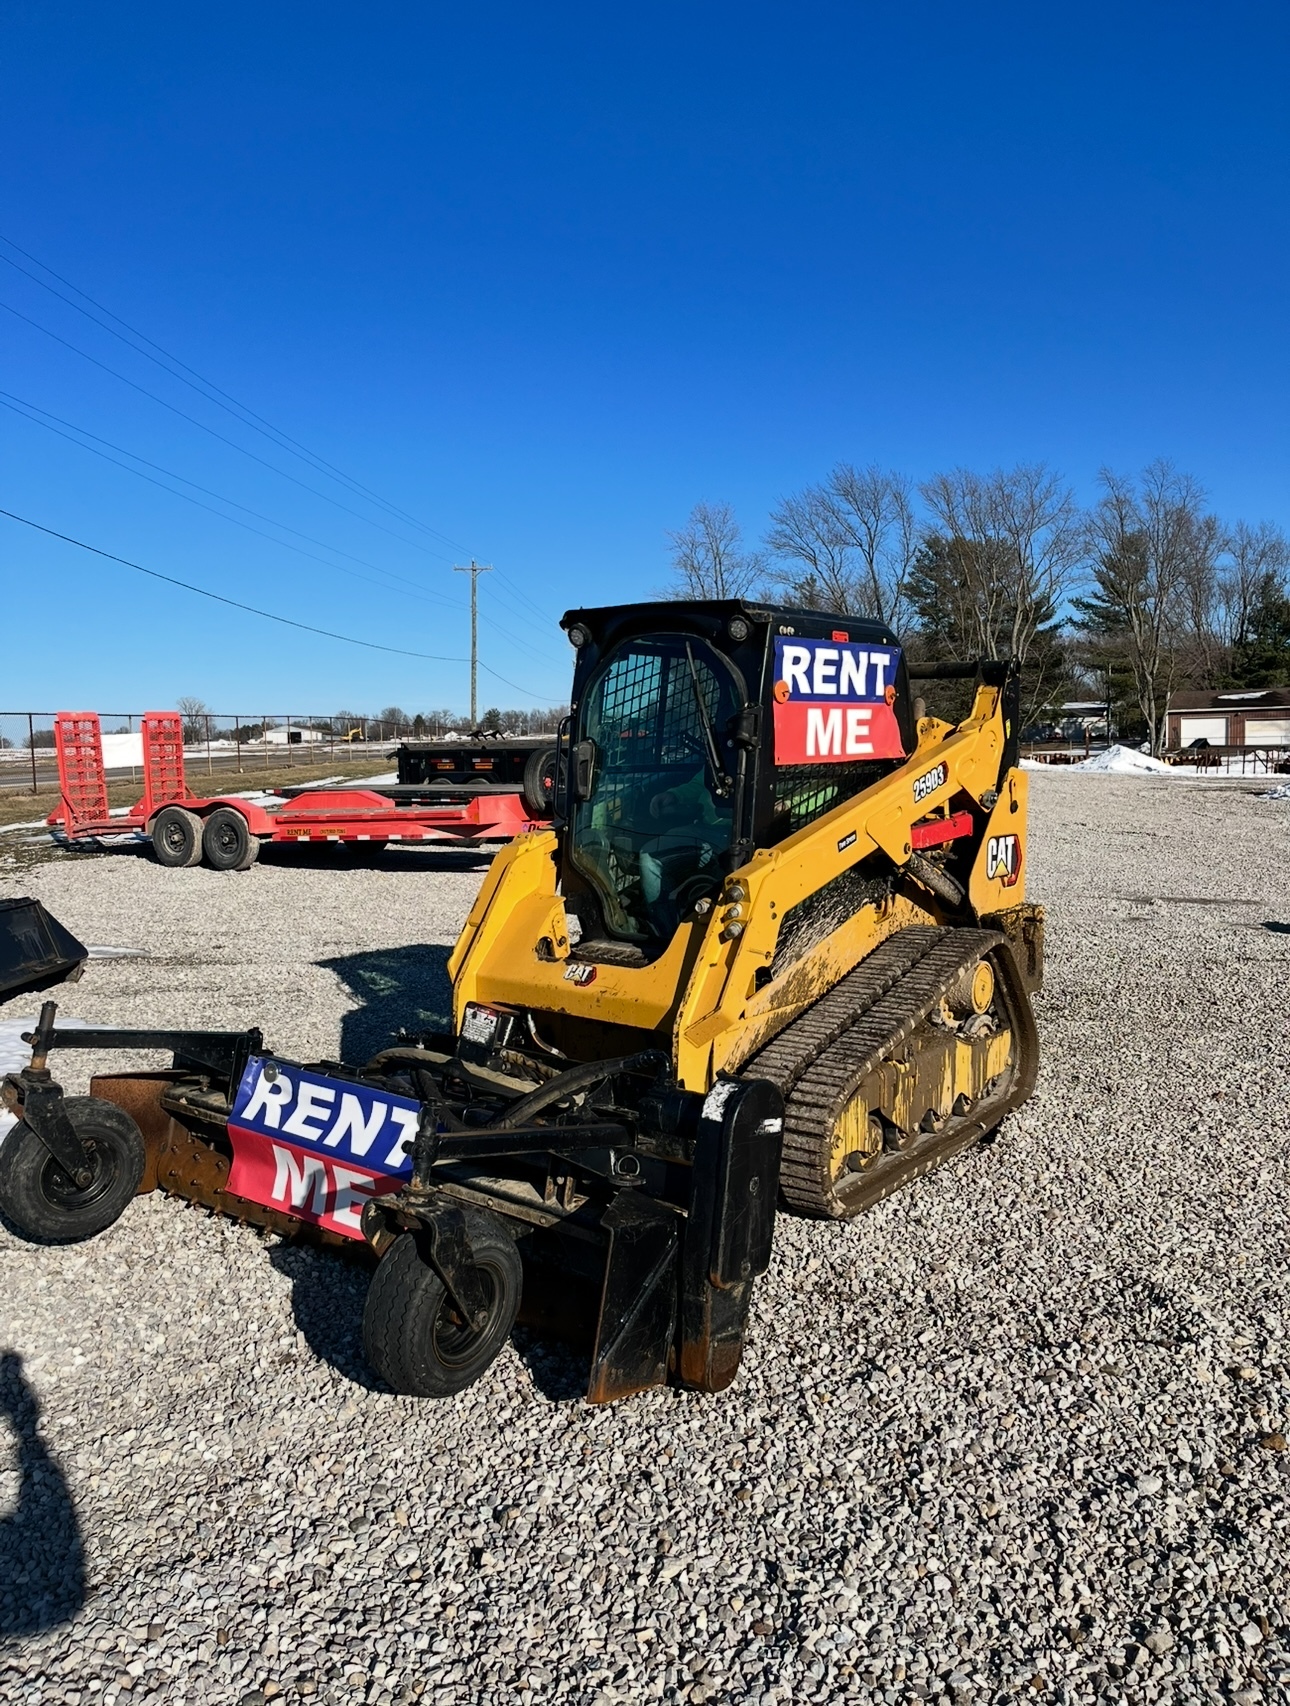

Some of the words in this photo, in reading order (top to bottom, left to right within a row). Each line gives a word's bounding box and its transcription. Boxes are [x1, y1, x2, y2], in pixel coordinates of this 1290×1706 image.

[782, 645, 891, 696] RENT
[806, 708, 874, 756] ME
[913, 764, 945, 803] 259D3
[286, 828, 302, 836] RENT
[302, 828, 312, 836] ME
[987, 836, 1015, 878] CAT
[564, 964, 593, 983] CAT
[241, 1068, 421, 1168] RENT
[271, 1145, 375, 1231] ME
